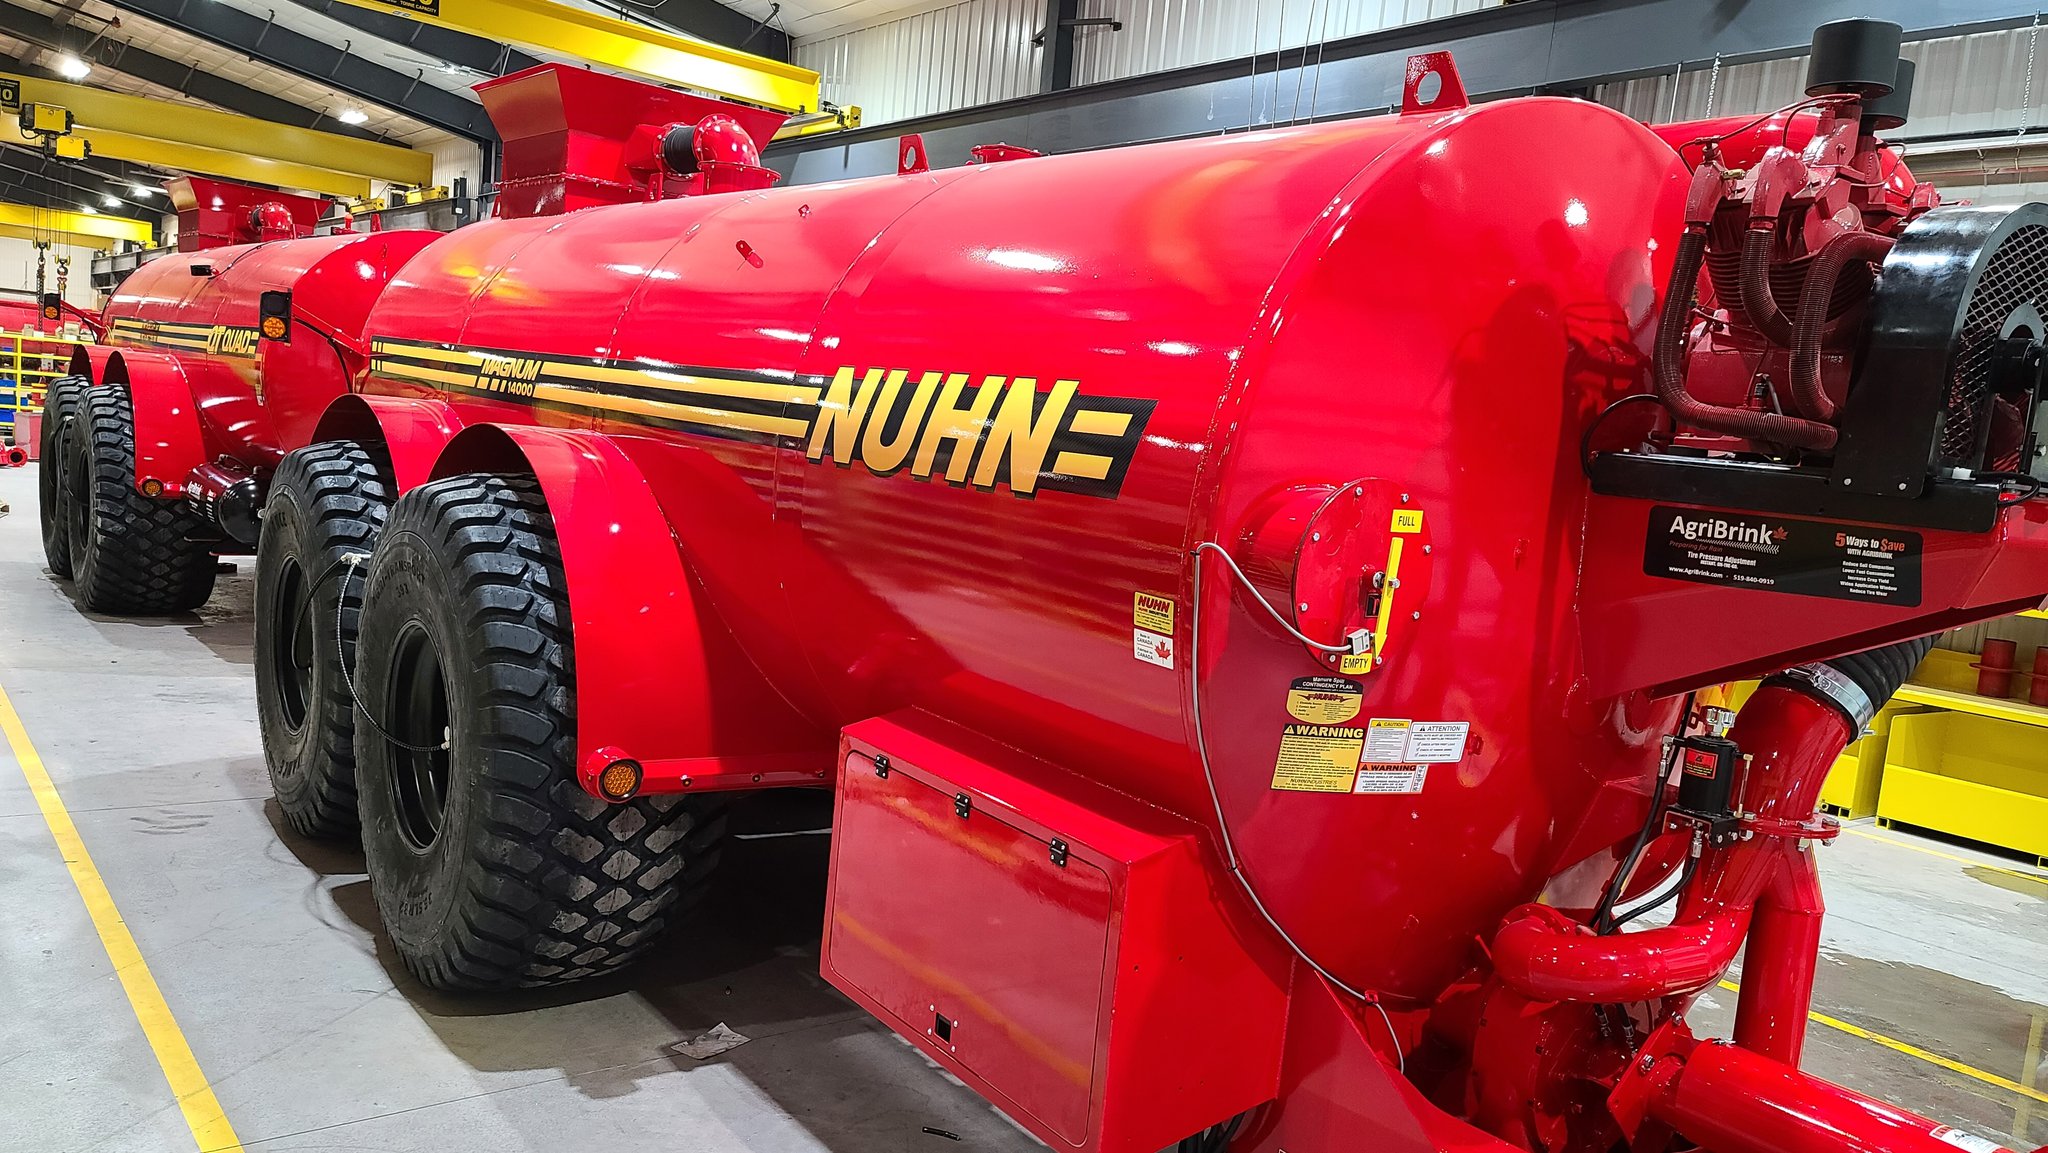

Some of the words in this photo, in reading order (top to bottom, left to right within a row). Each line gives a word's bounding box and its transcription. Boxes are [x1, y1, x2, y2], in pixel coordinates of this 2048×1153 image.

[222, 328, 252, 354] QUAD
[480, 356, 542, 381] MAGNUM
[507, 381, 533, 397] 14000
[805, 365, 1080, 499] NUHN
[1397, 515, 1416, 527] FULL
[1670, 516, 1773, 544] AgriBrink
[1669, 540, 1697, 551] Preparing
[1698, 543, 1708, 552] for
[1835, 533, 1846, 547] 5
[1846, 535, 1869, 548] Ways
[1871, 539, 1879, 548] to
[1687, 551, 1699, 559] Tire
[1698, 552, 1724, 562] Pressure
[1724, 556, 1757, 567] Adjustment
[1847, 548, 1861, 556] WITH
[1862, 550, 1893, 559] AGRIBRINK
[1668, 566, 1724, 579] www.AgriBrink.com
[1733, 574, 1775, 585] 519-840-0919
[1137, 595, 1170, 614] NUHN
[1136, 637, 1154, 646] CANADA
[1136, 651, 1154, 661] CANADA
[1343, 657, 1369, 669] EMPTY
[1302, 681, 1340, 689] CONTINGENCY
[1296, 724, 1364, 739] WARNING
[1370, 764, 1417, 772] WARNING
